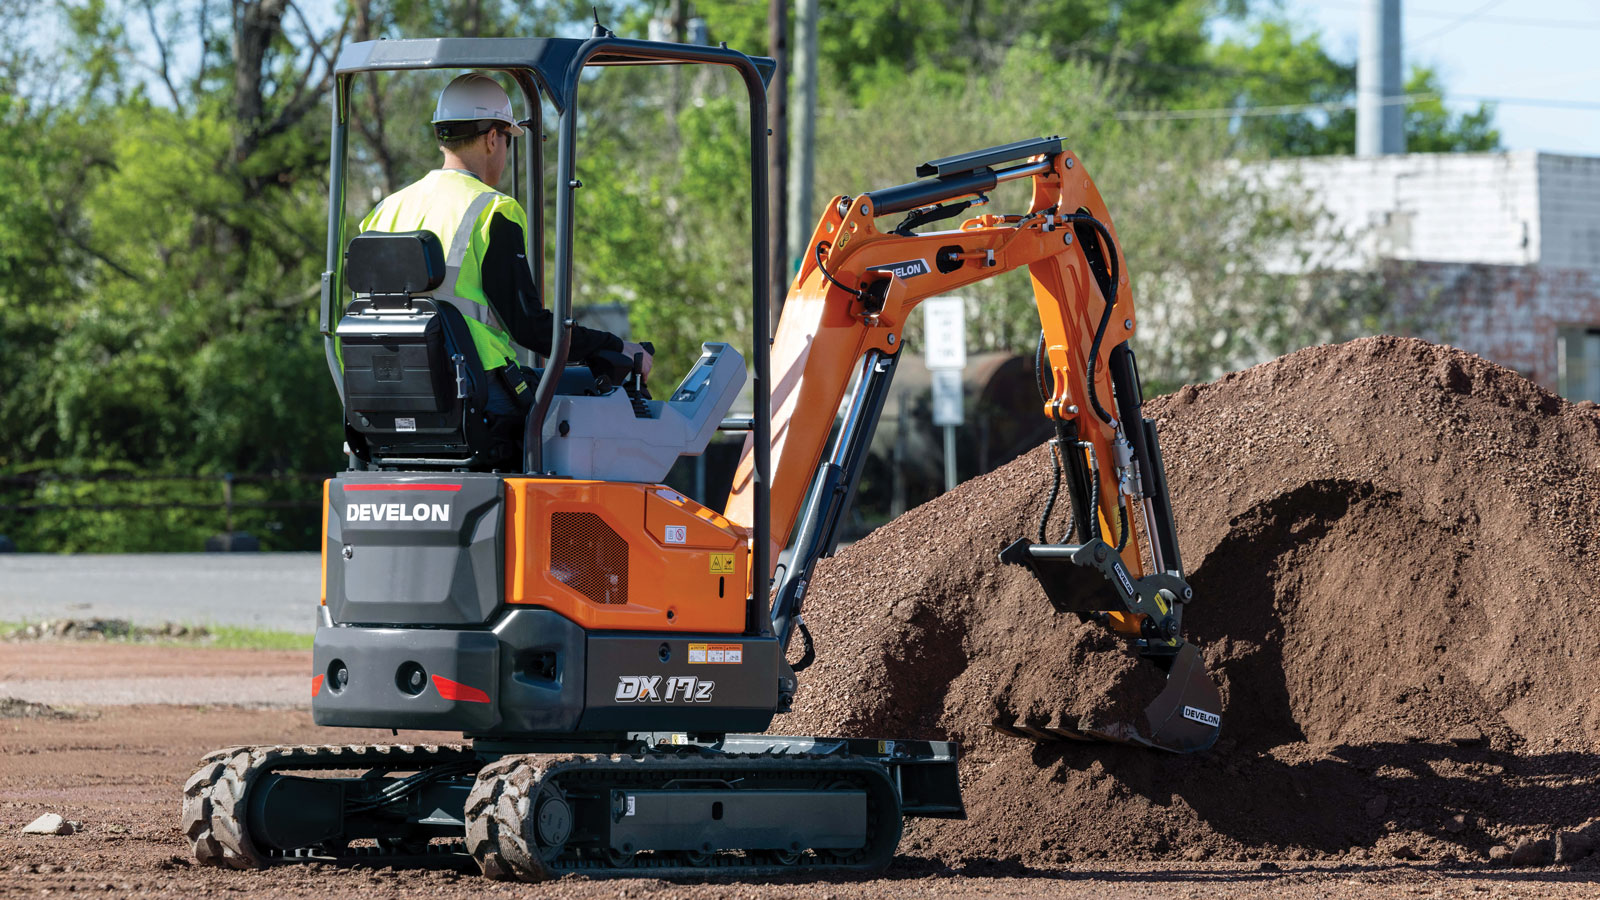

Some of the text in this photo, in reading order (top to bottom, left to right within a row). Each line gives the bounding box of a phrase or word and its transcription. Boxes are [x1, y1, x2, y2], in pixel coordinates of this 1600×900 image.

[892, 263, 921, 277] ELON
[346, 503, 450, 522] DEVELON
[615, 676, 662, 702] DX
[1185, 707, 1219, 725] DEVELON
